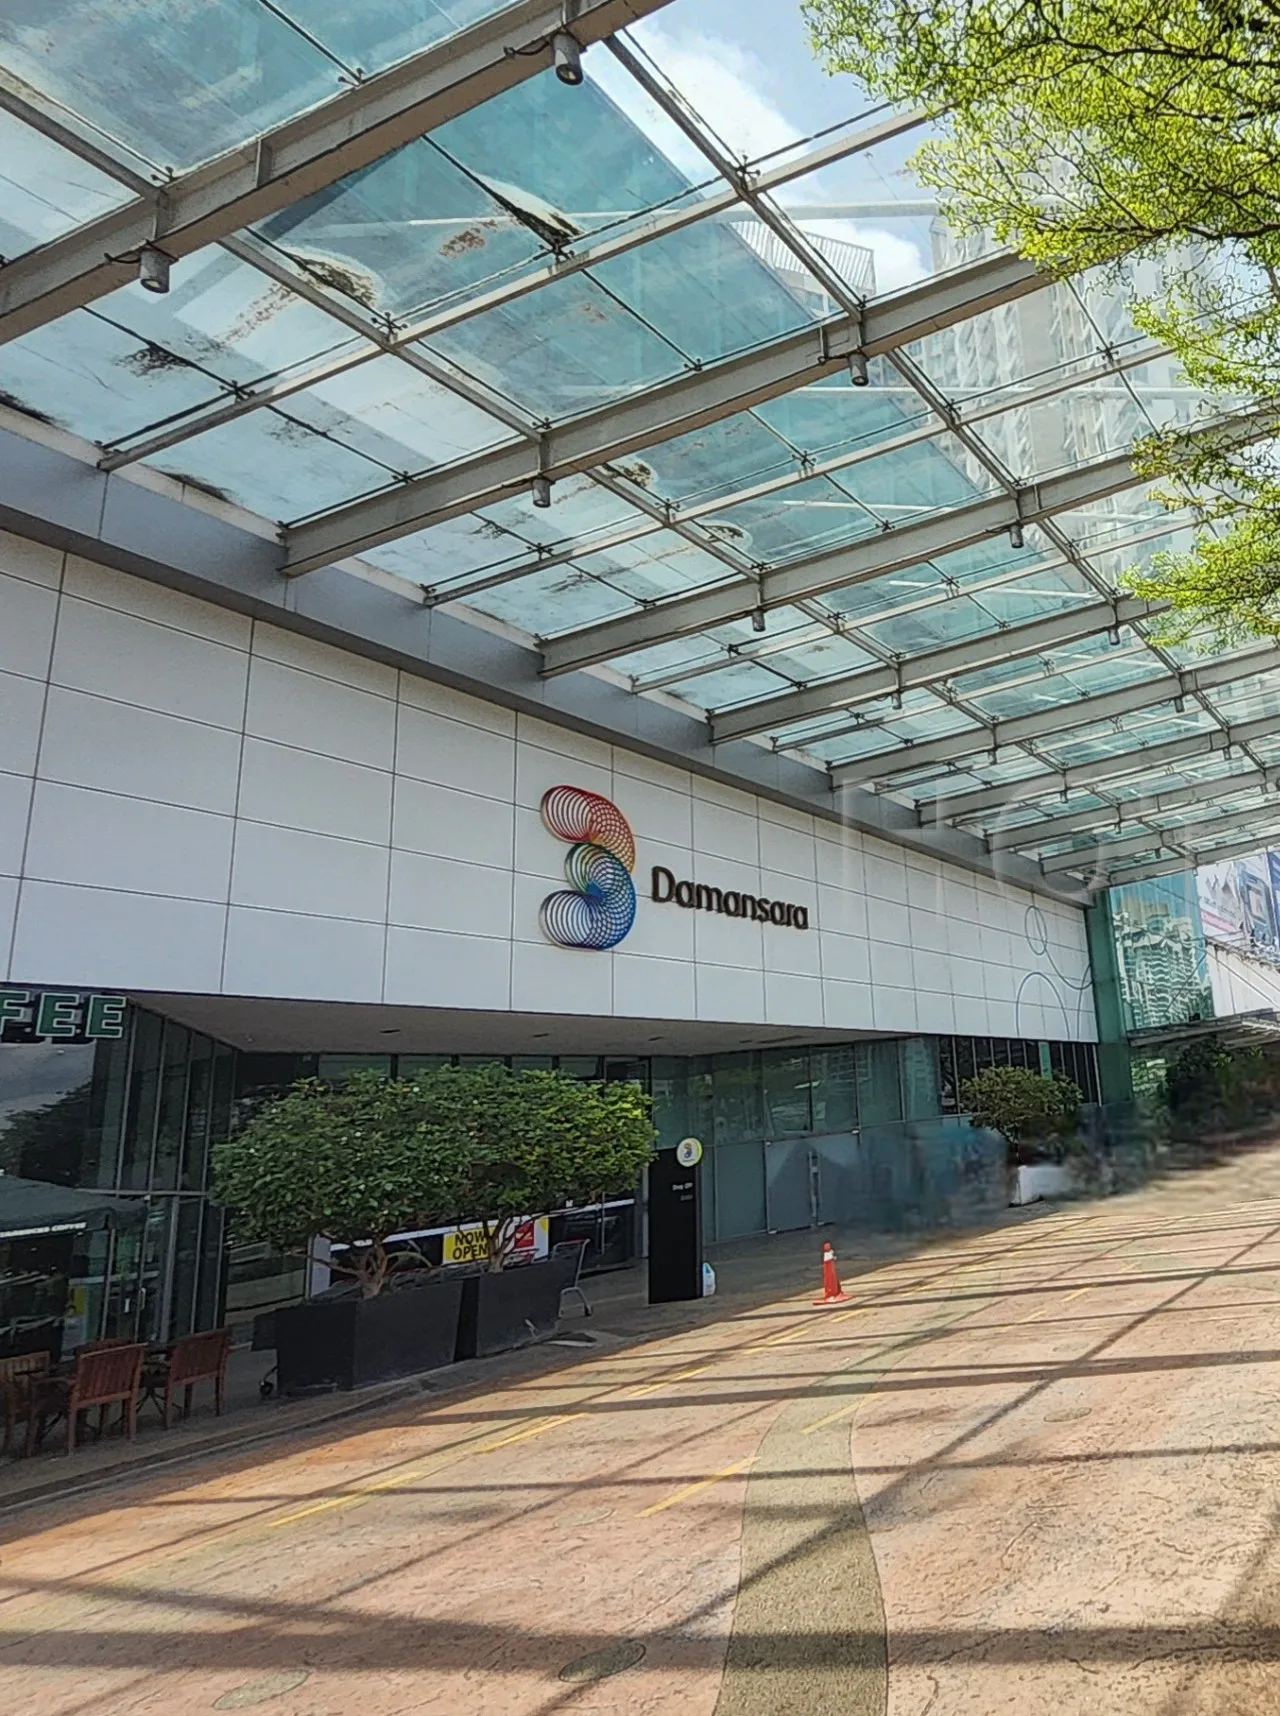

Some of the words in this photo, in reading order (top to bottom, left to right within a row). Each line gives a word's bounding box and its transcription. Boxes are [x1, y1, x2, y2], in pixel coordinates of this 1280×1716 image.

[650, 865, 809, 930] Damansara
[0, 988, 127, 1038] FEE
[452, 1243, 488, 1260] OPEN
[455, 1230, 486, 1246] NOW
